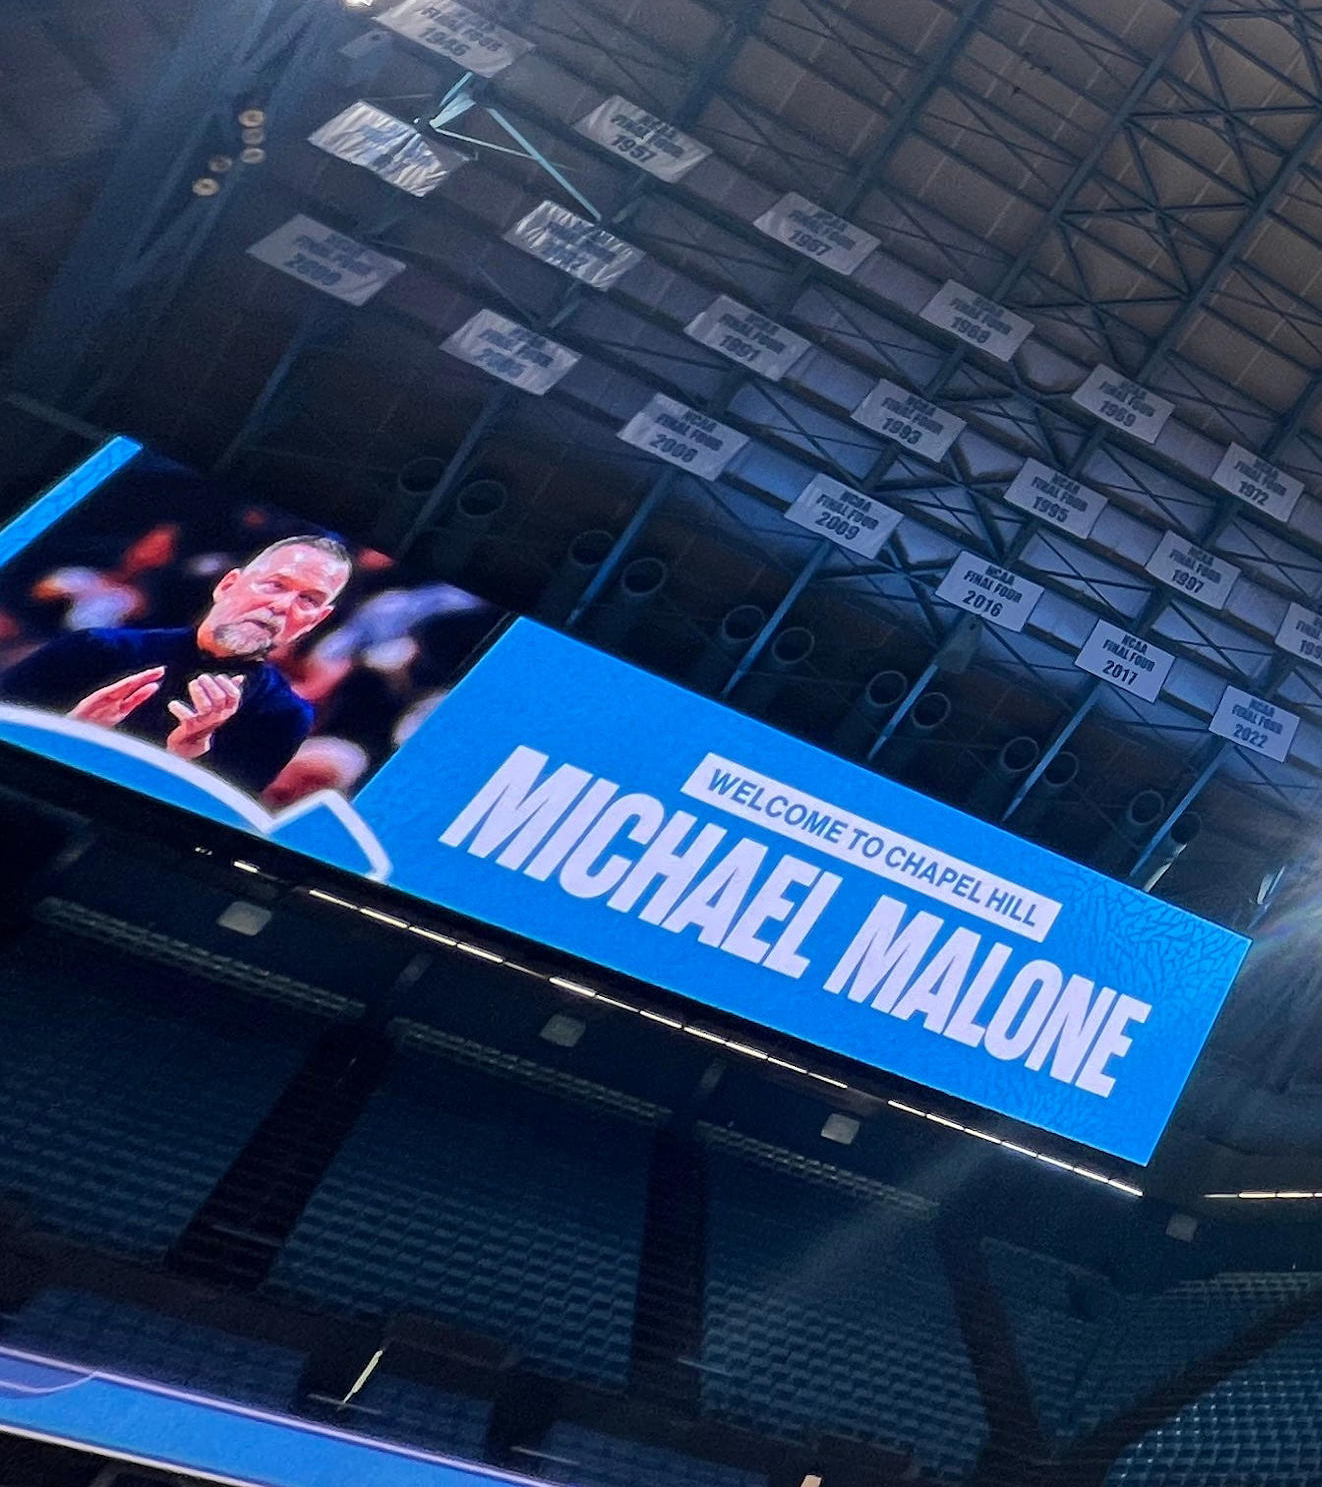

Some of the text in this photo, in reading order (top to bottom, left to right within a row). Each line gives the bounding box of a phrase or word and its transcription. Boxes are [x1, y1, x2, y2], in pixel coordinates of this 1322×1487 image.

[612, 134, 657, 161] 1957
[881, 397, 943, 434] FINAL FOUR
[656, 414, 723, 451] FINAL FOUR
[882, 417, 922, 445] 1993
[652, 434, 698, 463] 2008
[841, 492, 872, 512] NCAA
[1032, 477, 1088, 512] FINAL FOUR
[1239, 481, 1269, 506] 1972
[817, 494, 879, 530] FINAL FOUR
[1034, 496, 1067, 523] 1995
[816, 514, 859, 540] 2009
[985, 565, 1015, 586] NCAA
[1169, 549, 1221, 584] FINAL FOUR
[964, 571, 1023, 603] FINAL FOUR
[1172, 570, 1204, 593] 1997
[962, 591, 1003, 617] 2016
[1102, 639, 1156, 671] FINAL FOUR
[1121, 634, 1148, 654] NCAA
[1102, 660, 1139, 685] 2017
[1232, 704, 1283, 734] FINAL FOUR
[1249, 698, 1276, 717] NCAA
[1234, 724, 1268, 748] 2022
[707, 768, 1041, 928] WELCOME TO CHAPEL HILL
[439, 745, 1151, 1098] MICHAEL MALONE
